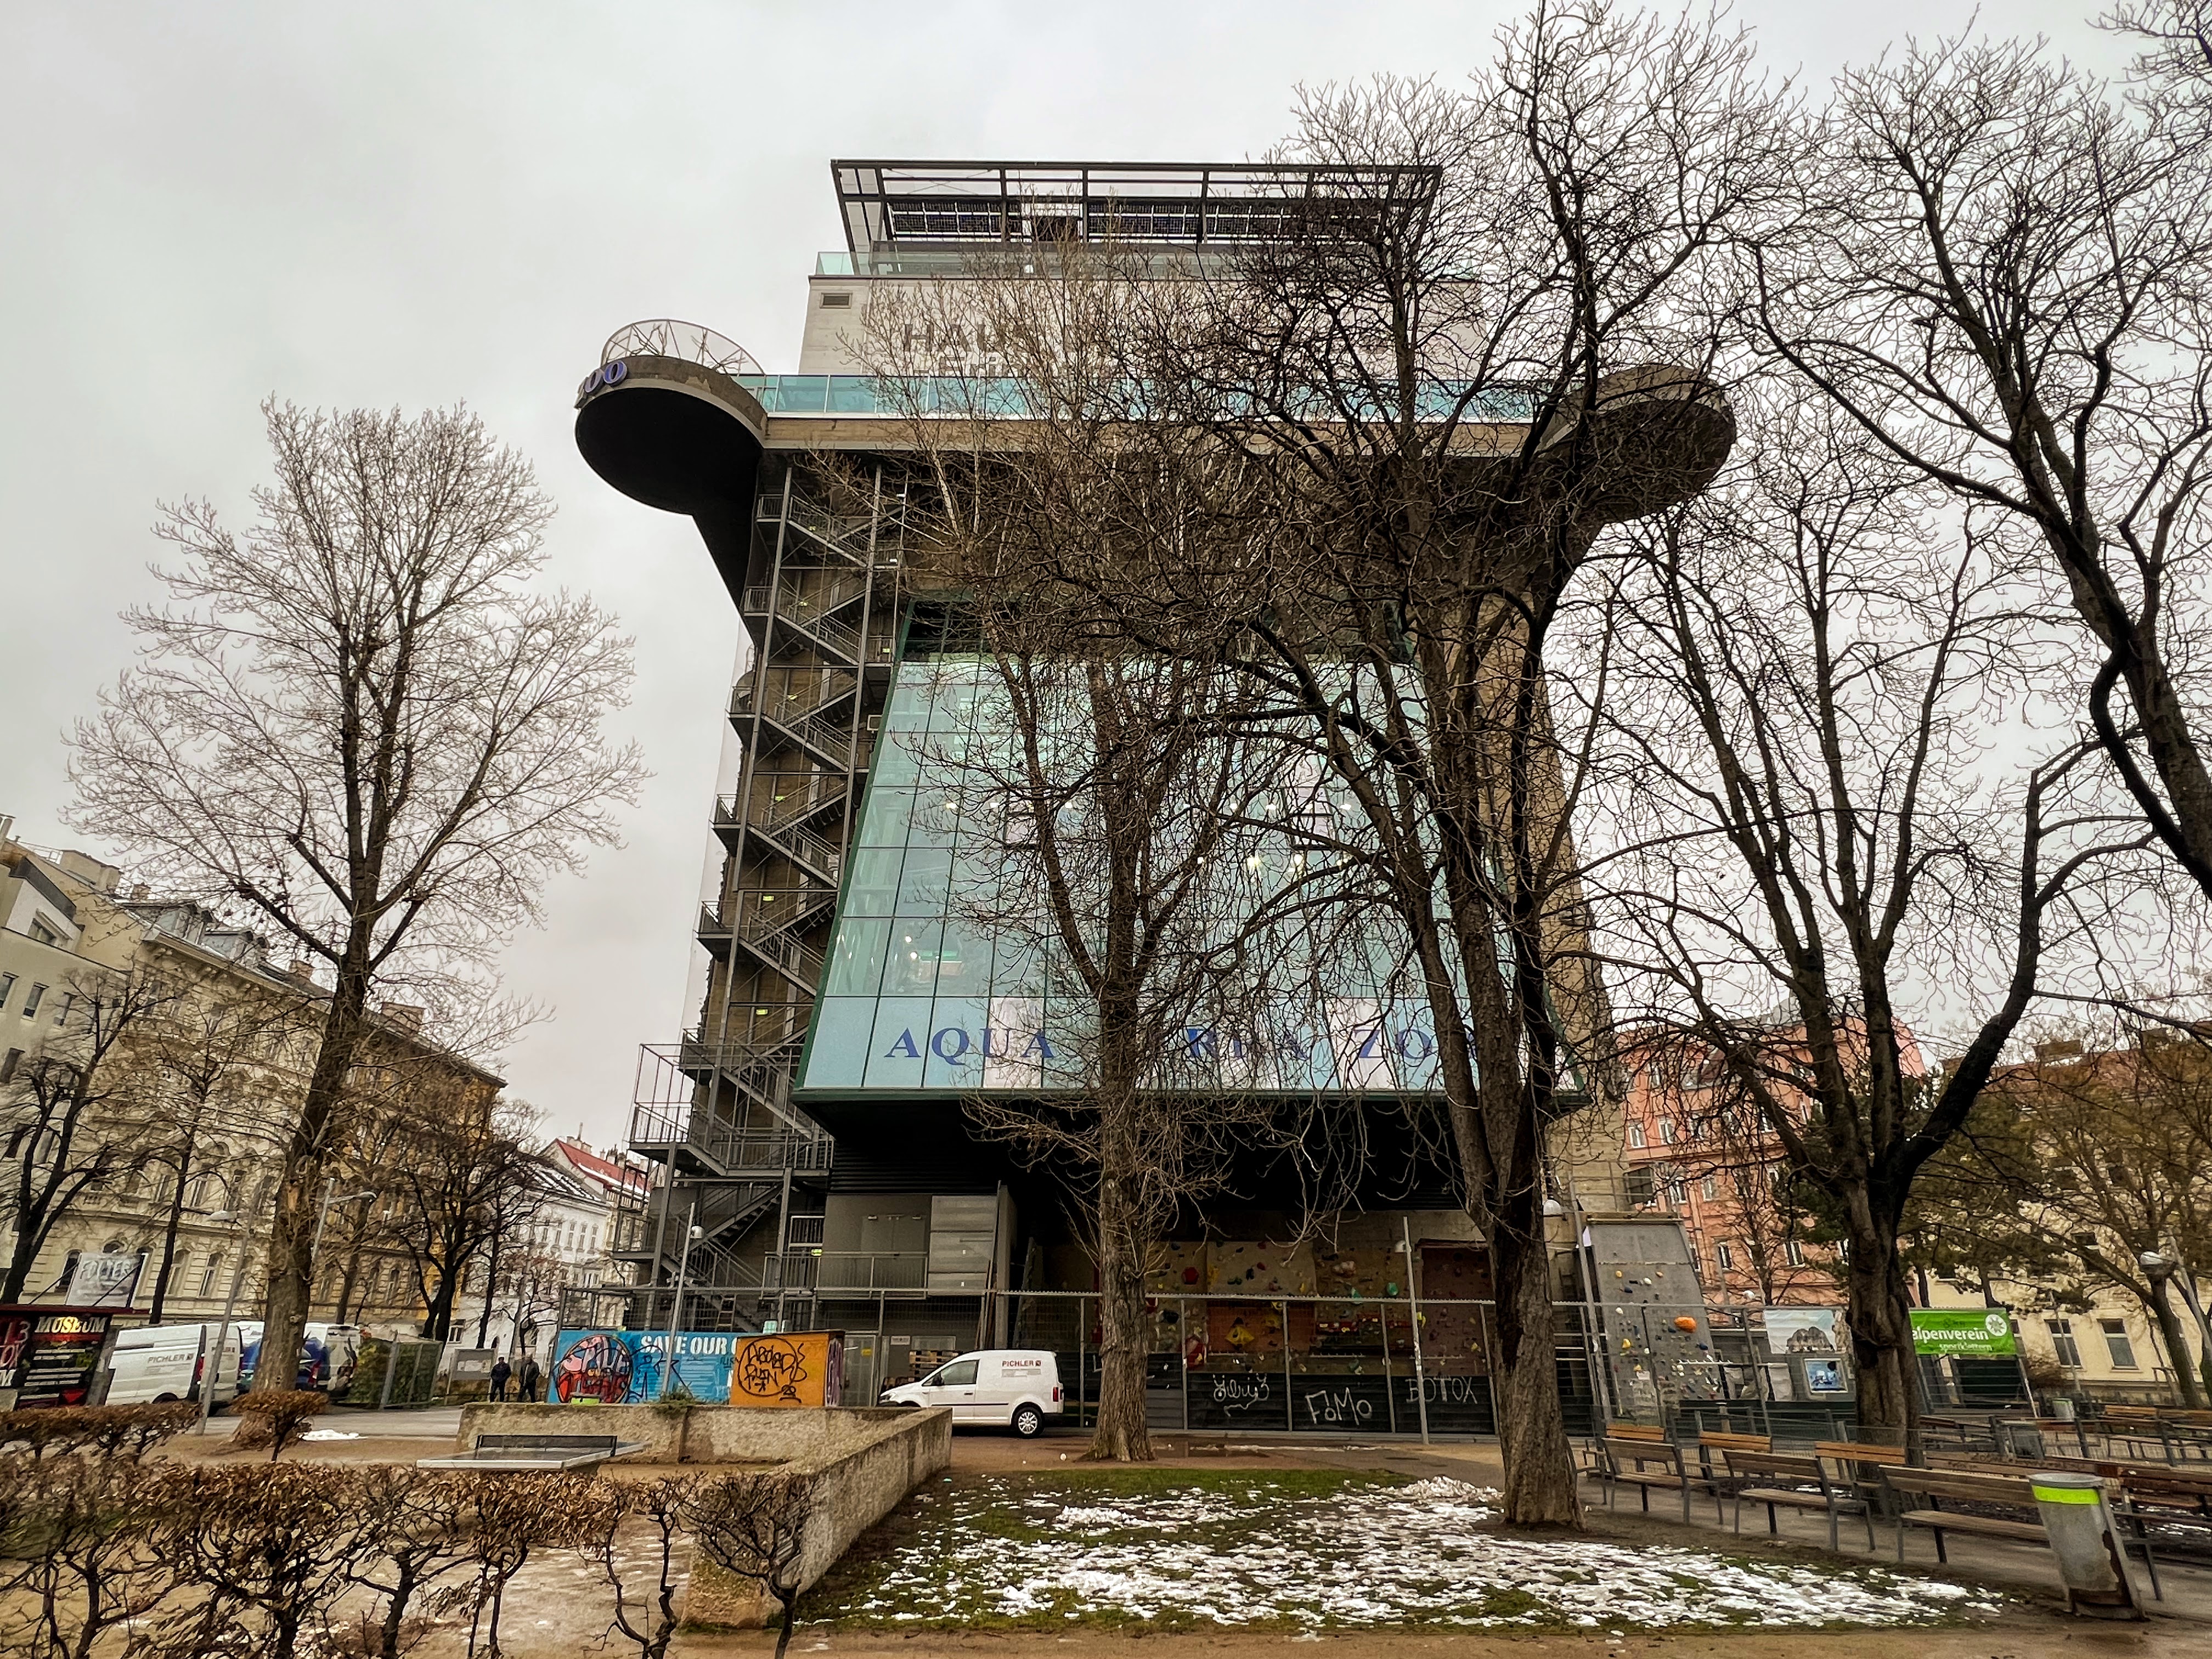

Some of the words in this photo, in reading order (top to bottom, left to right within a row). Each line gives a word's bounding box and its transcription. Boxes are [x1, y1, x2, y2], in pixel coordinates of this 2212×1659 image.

[884, 1026, 1054, 1066] AQUA
[1352, 1028, 1479, 1060] ZO
[35, 1317, 108, 1333] MUSEUM
[1911, 1325, 1989, 1344] alpenverein
[690, 1336, 727, 1355] OUR
[148, 1354, 185, 1363] PICHLER
[1405, 1375, 1478, 1404] BOTOX
